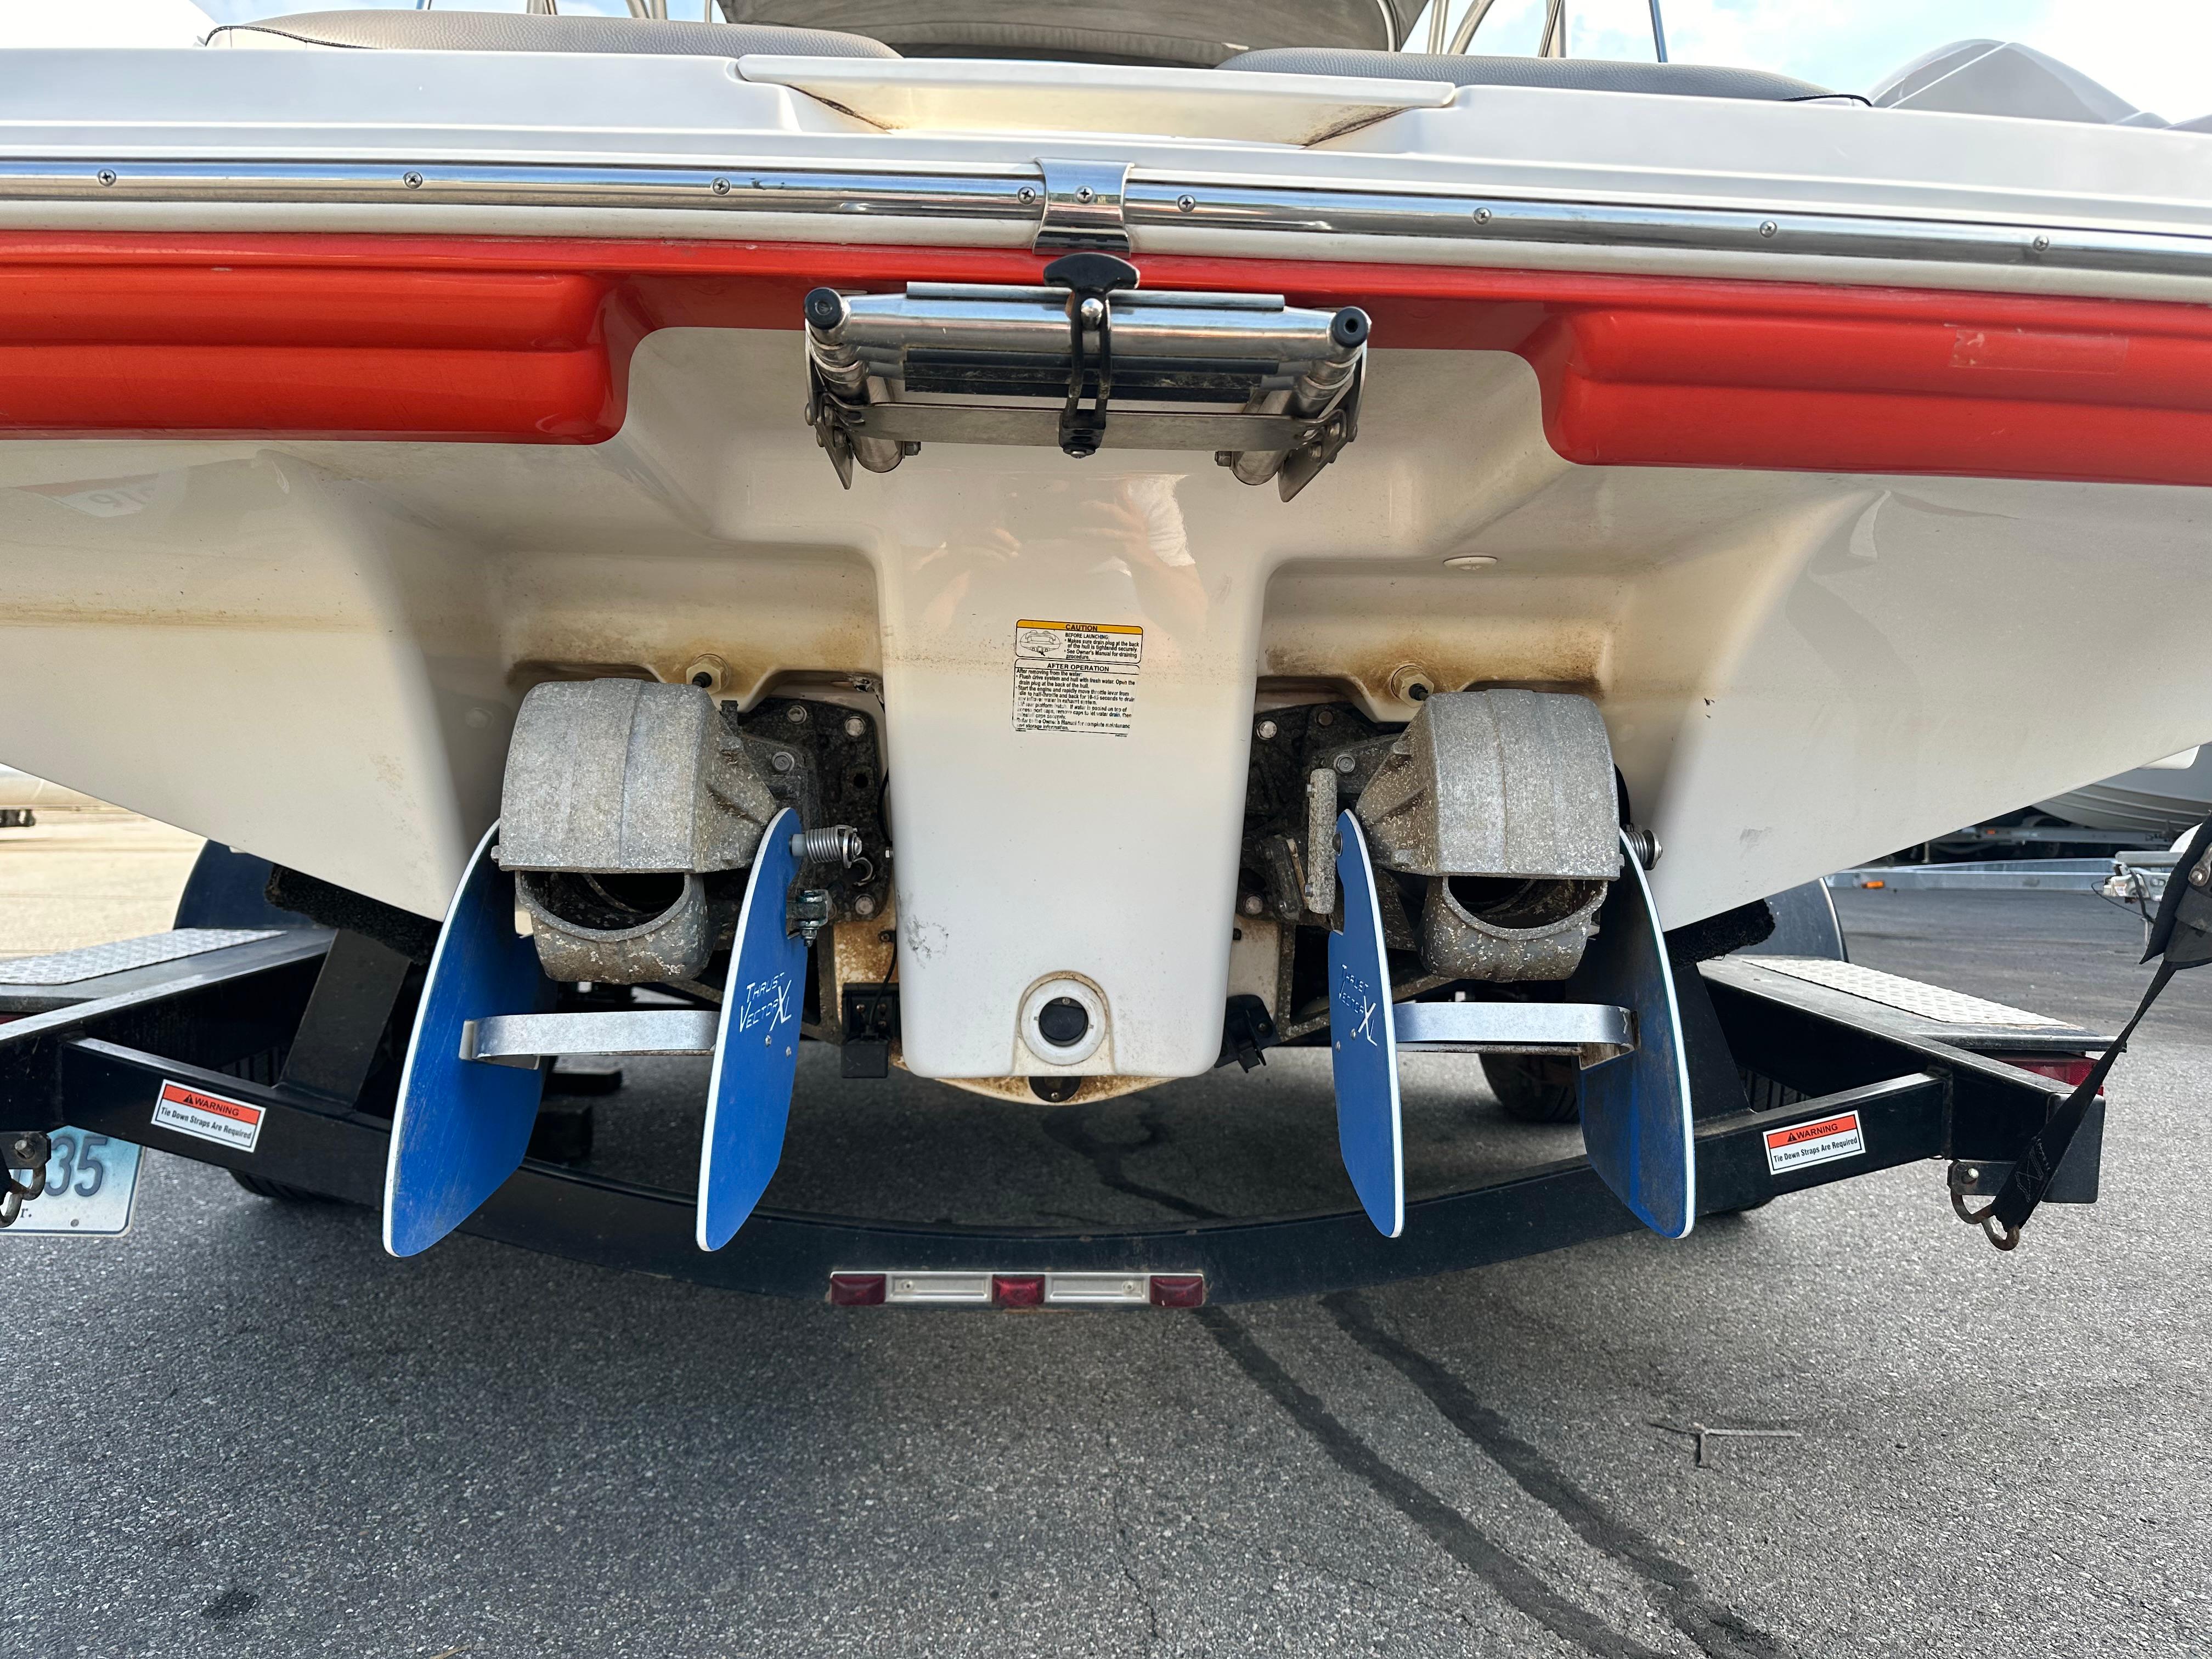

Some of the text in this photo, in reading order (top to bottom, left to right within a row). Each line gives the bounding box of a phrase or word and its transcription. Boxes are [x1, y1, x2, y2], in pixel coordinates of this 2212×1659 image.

[747, 972, 785, 1003] THRUST
[740, 979, 792, 1032] VECTOR XL
[195, 1096, 240, 1117] WARNING
[161, 1107, 252, 1140] Tie Down Straps Are Required
[1796, 1123, 1838, 1139] WARNING
[1784, 1152, 1801, 1161] Down
[1801, 1147, 1820, 1156] Straps
[1821, 1144, 1831, 1152] Are
[1832, 1137, 1858, 1149] Required
[14, 1136, 108, 1197] 35
